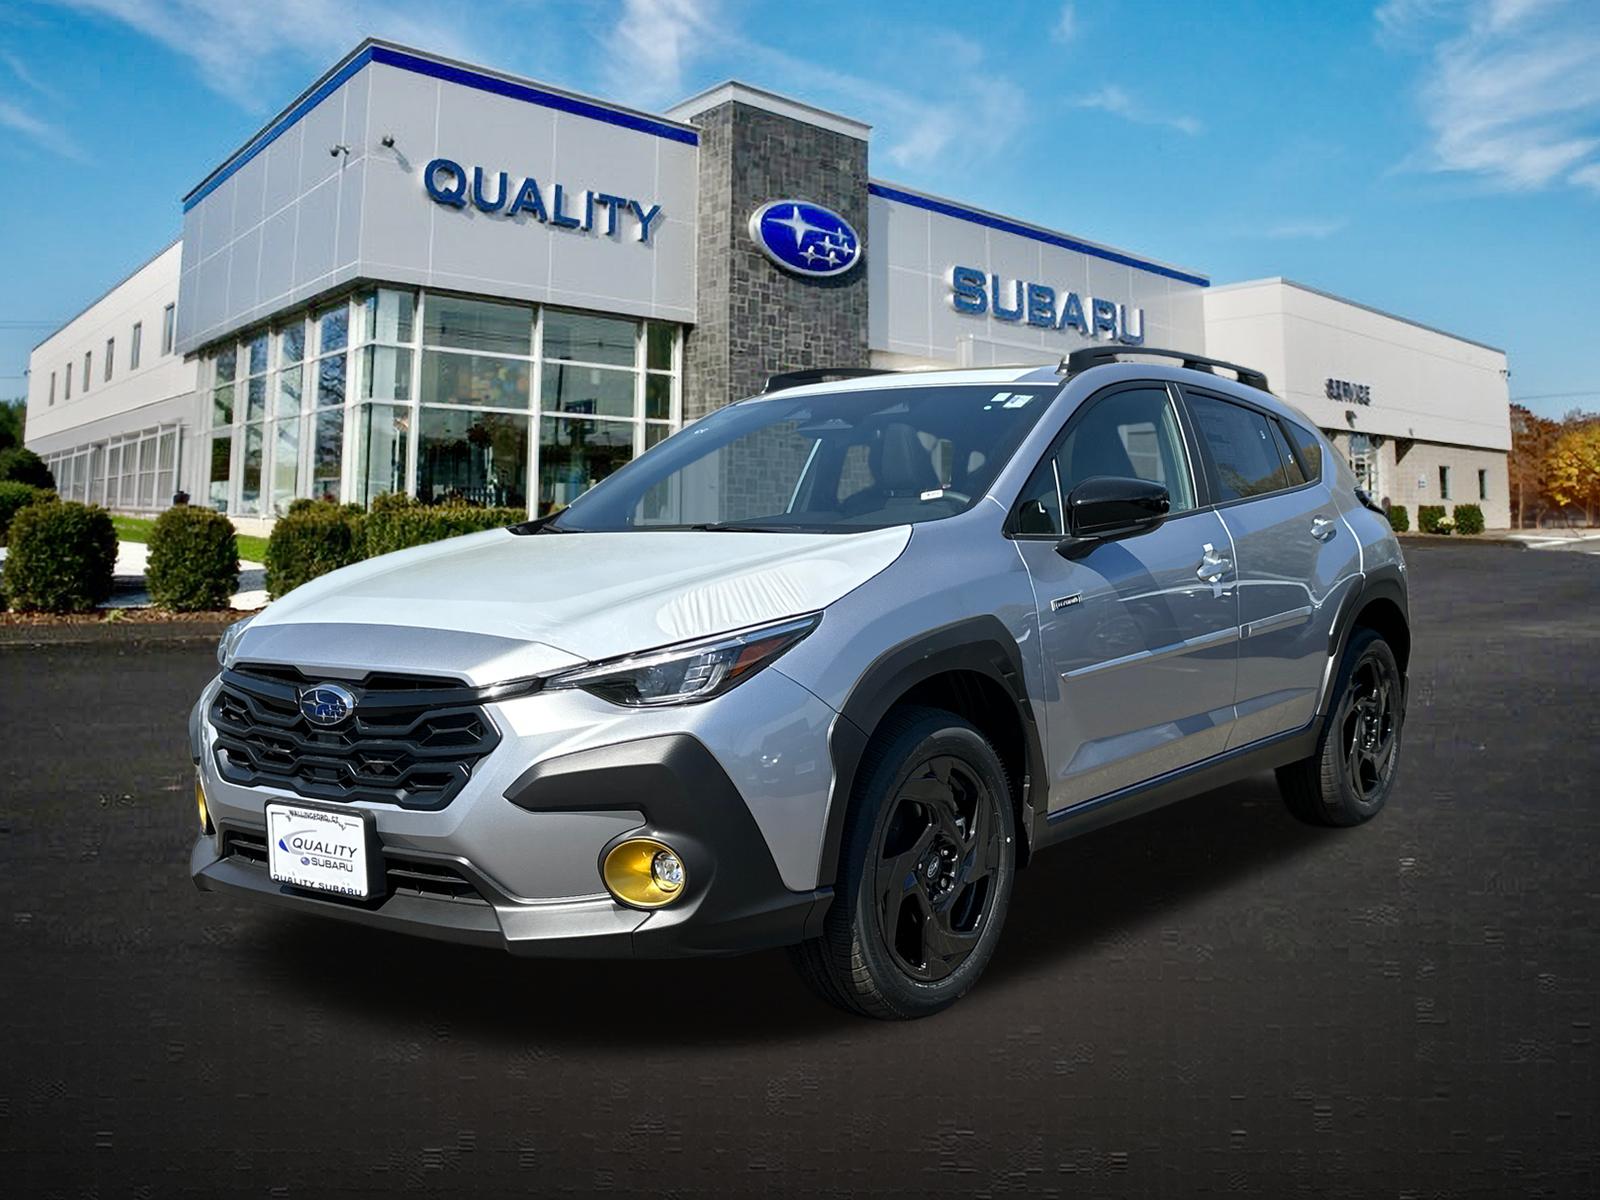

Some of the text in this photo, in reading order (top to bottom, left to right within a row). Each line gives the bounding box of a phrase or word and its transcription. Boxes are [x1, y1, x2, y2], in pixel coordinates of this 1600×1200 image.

[424, 158, 661, 242] QUALITY
[952, 265, 1144, 346] SUBARU
[292, 837, 358, 858] QUALITY
[311, 857, 354, 873] SUBARU
[273, 873, 362, 896] QUALITY SUBARU
